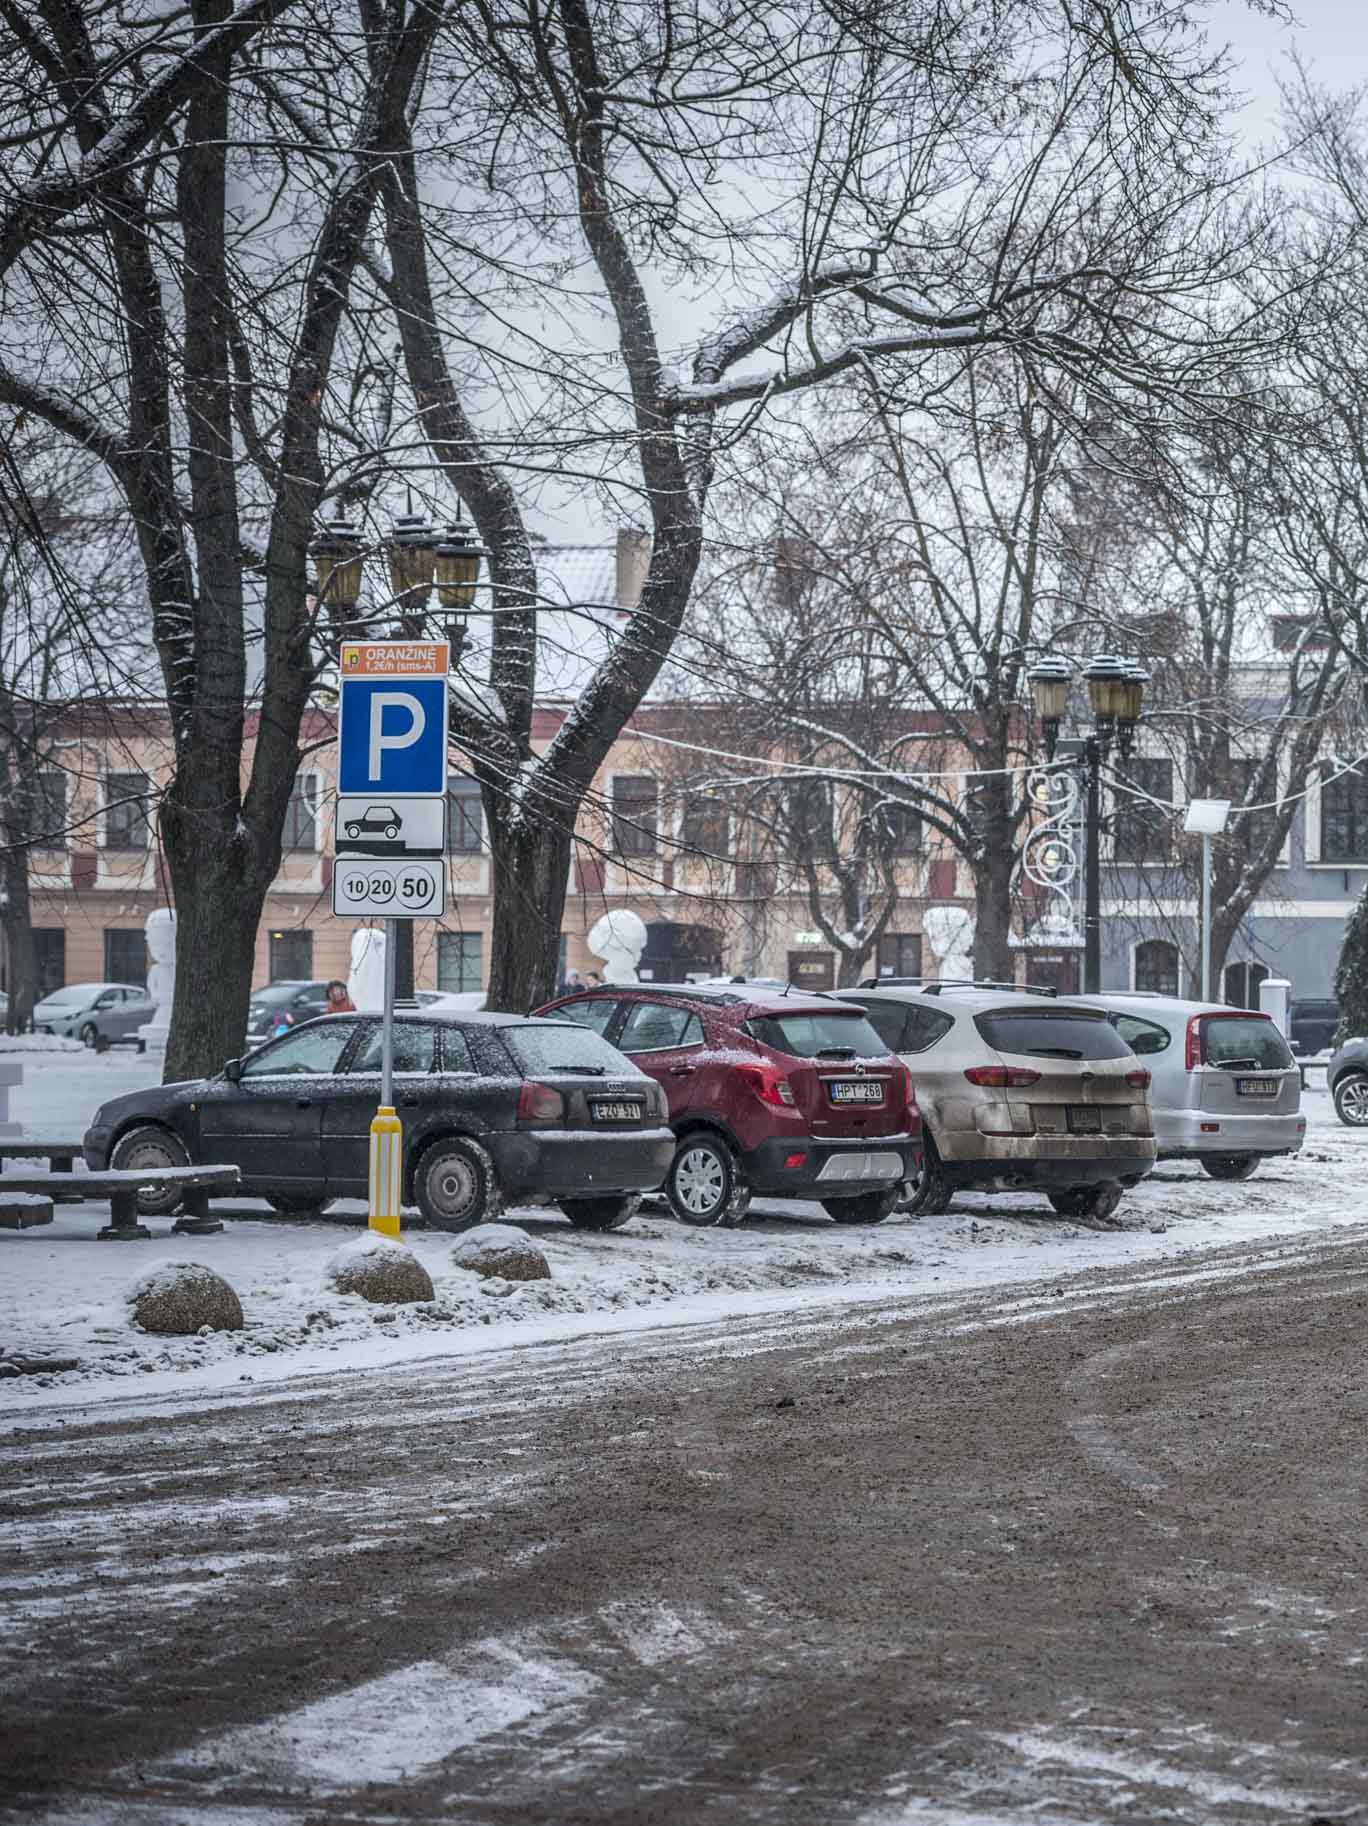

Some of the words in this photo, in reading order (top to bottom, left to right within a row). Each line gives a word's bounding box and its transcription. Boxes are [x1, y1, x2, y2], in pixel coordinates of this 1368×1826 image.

[365, 644, 437, 660] ORANŽINĖ
[368, 692, 426, 781] P
[347, 881, 364, 894] 10
[371, 880, 392, 895] 20
[402, 878, 428, 898] 50
[838, 1084, 858, 1097] HPT
